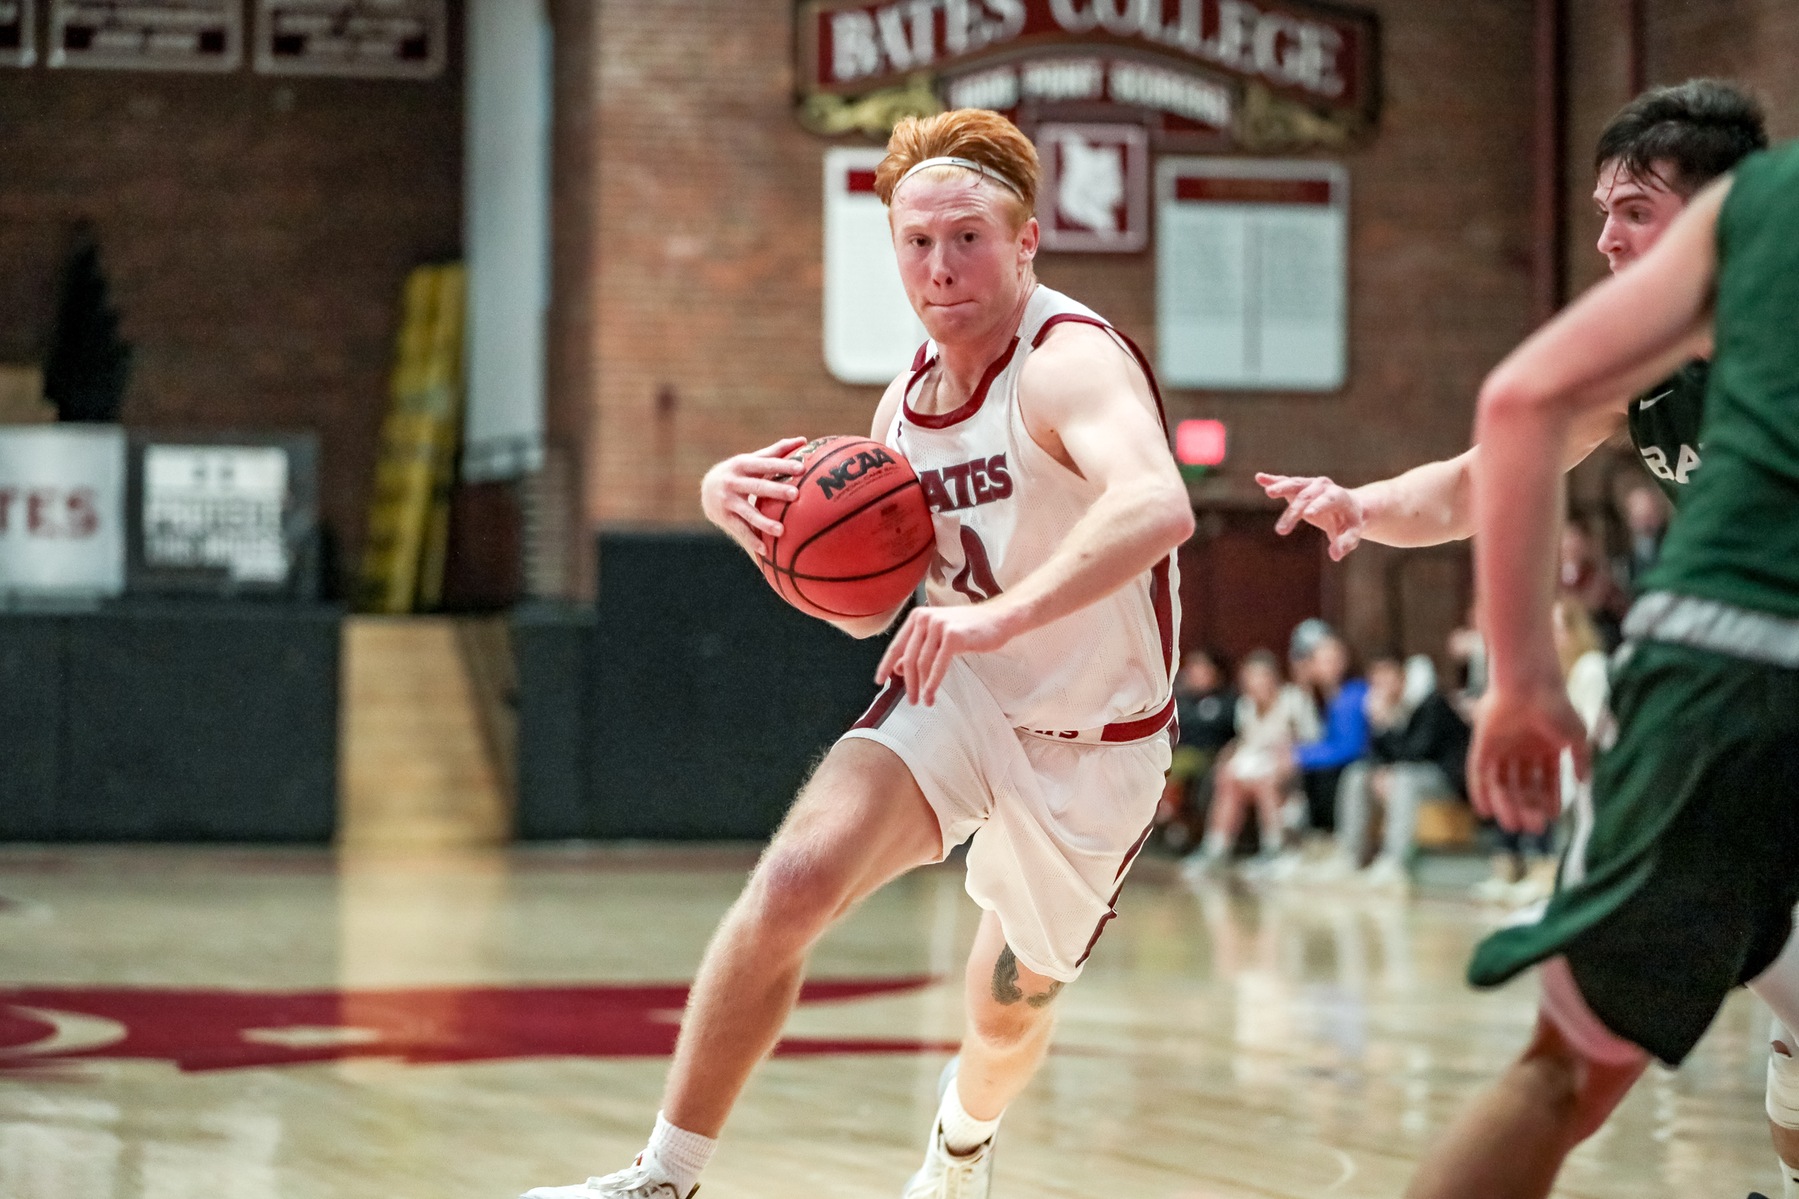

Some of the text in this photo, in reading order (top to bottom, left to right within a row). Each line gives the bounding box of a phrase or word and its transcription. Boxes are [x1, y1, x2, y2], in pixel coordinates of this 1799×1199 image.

[831, 0, 1026, 82] BATES
[816, 448, 897, 500] NCAA
[919, 451, 1013, 513] ATES
[1640, 443, 1703, 484] BA
